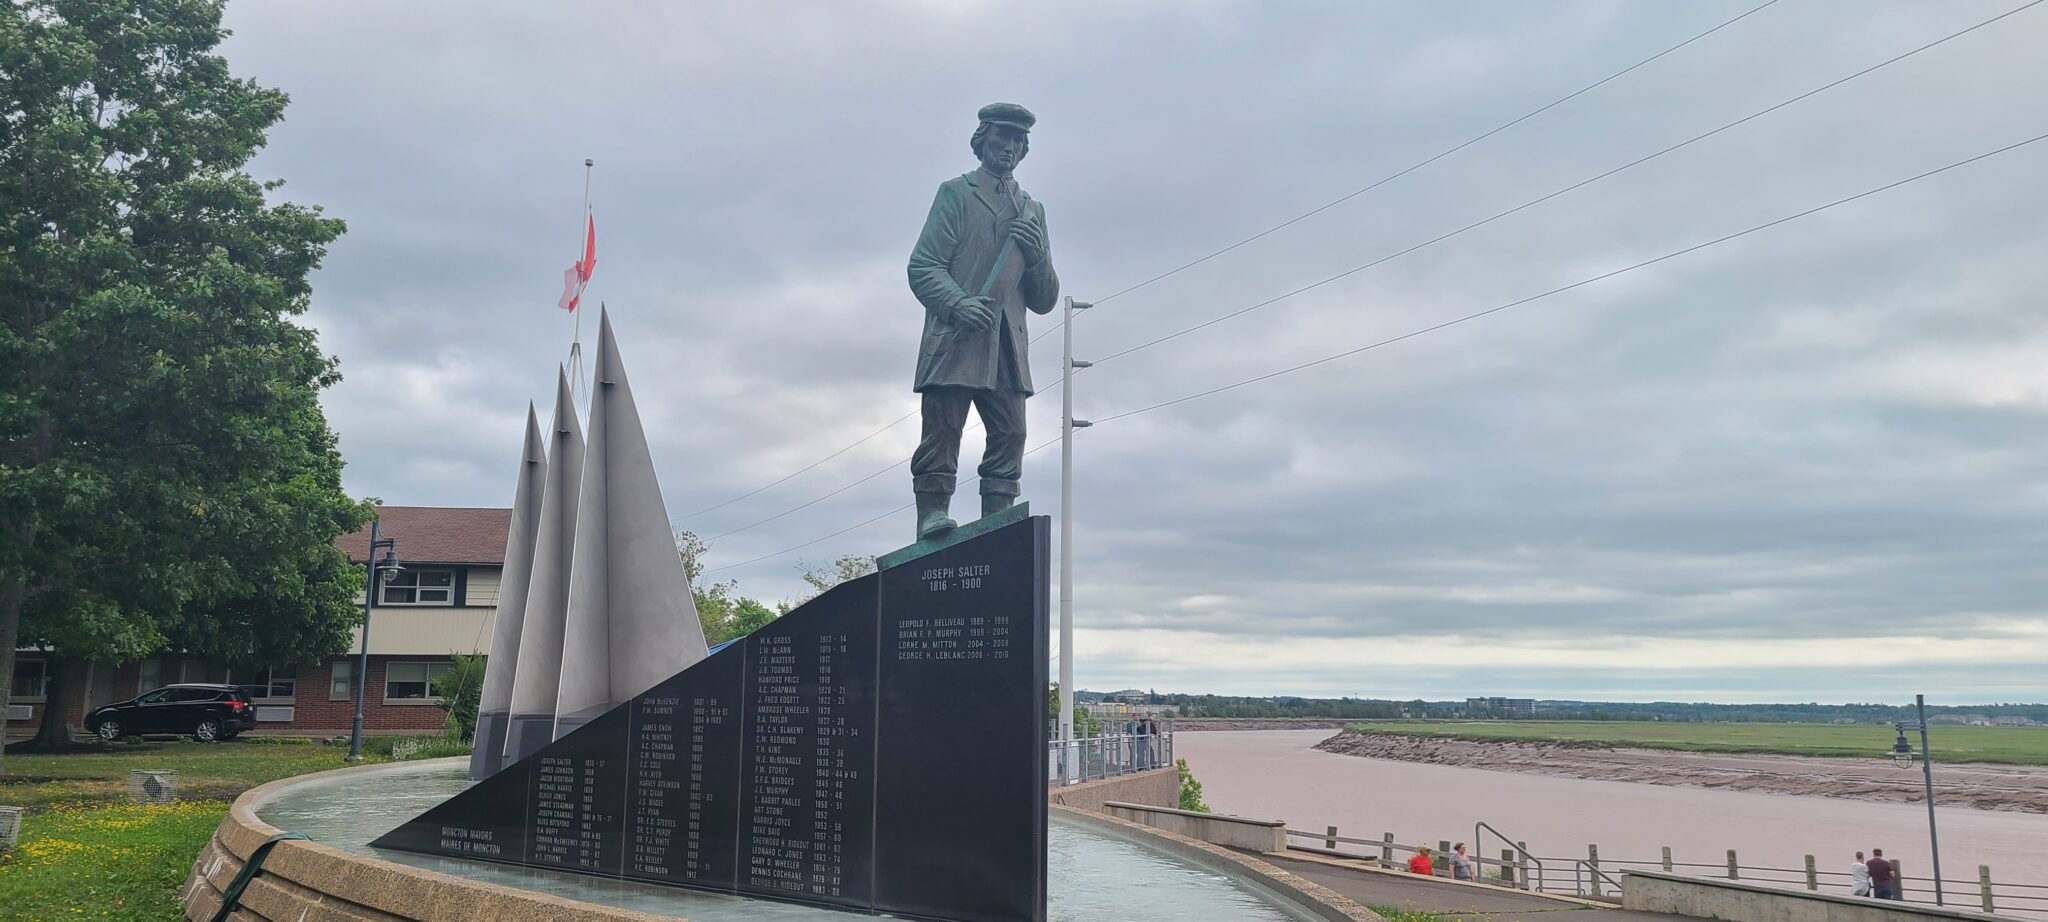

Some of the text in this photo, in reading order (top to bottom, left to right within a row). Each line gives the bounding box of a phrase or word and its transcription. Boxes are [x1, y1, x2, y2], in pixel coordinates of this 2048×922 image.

[922, 565, 990, 580] JOSEPH SALTER
[930, 581, 946, 591] 1816
[962, 578, 981, 589] 1900
[899, 620, 923, 628] LEOPOLD
[935, 618, 964, 627] BELLIVEAU
[899, 631, 917, 639] BRIAN
[920, 630, 924, 638] F.
[936, 629, 961, 637] MURPHY
[993, 628, 1008, 636] 2004
[840, 635, 846, 643] 14
[899, 641, 918, 649] LORNE
[933, 640, 956, 648] MITTON
[968, 640, 983, 648] 2004
[899, 652, 922, 660] GEORGE
[936, 651, 965, 659] LEBLANC
[785, 706, 809, 714] WHEELER
[851, 728, 858, 736] 34
[770, 736, 796, 744] REDMOND
[769, 766, 788, 774] STOREY
[772, 777, 794, 785] BRIDGES
[766, 787, 788, 795] MURPHY
[781, 798, 800, 806] PARLEE
[836, 802, 843, 810] 51
[766, 807, 783, 815] STONE
[815, 811, 827, 819] 1952
[754, 817, 791, 826] HARRIS JOYCE
[442, 827, 492, 840] MONCTON MAYORS
[753, 826, 766, 834] MIKE
[815, 832, 826, 840] 1957
[753, 836, 779, 846] SHERWOOD
[788, 840, 809, 849] RIDEOUT
[441, 839, 500, 855] MAIRES DE MONCTON
[752, 847, 775, 856] LEONARD
[785, 850, 803, 859] JONES
[752, 857, 765, 865] GARY
[775, 859, 800, 869] WHEELER
[834, 855, 840, 863] 74
[752, 867, 802, 880] DENNIS COCHRANE
[834, 866, 840, 874] 79
[751, 878, 771, 887] GEORGE
[781, 881, 804, 891] RIDEOUT
